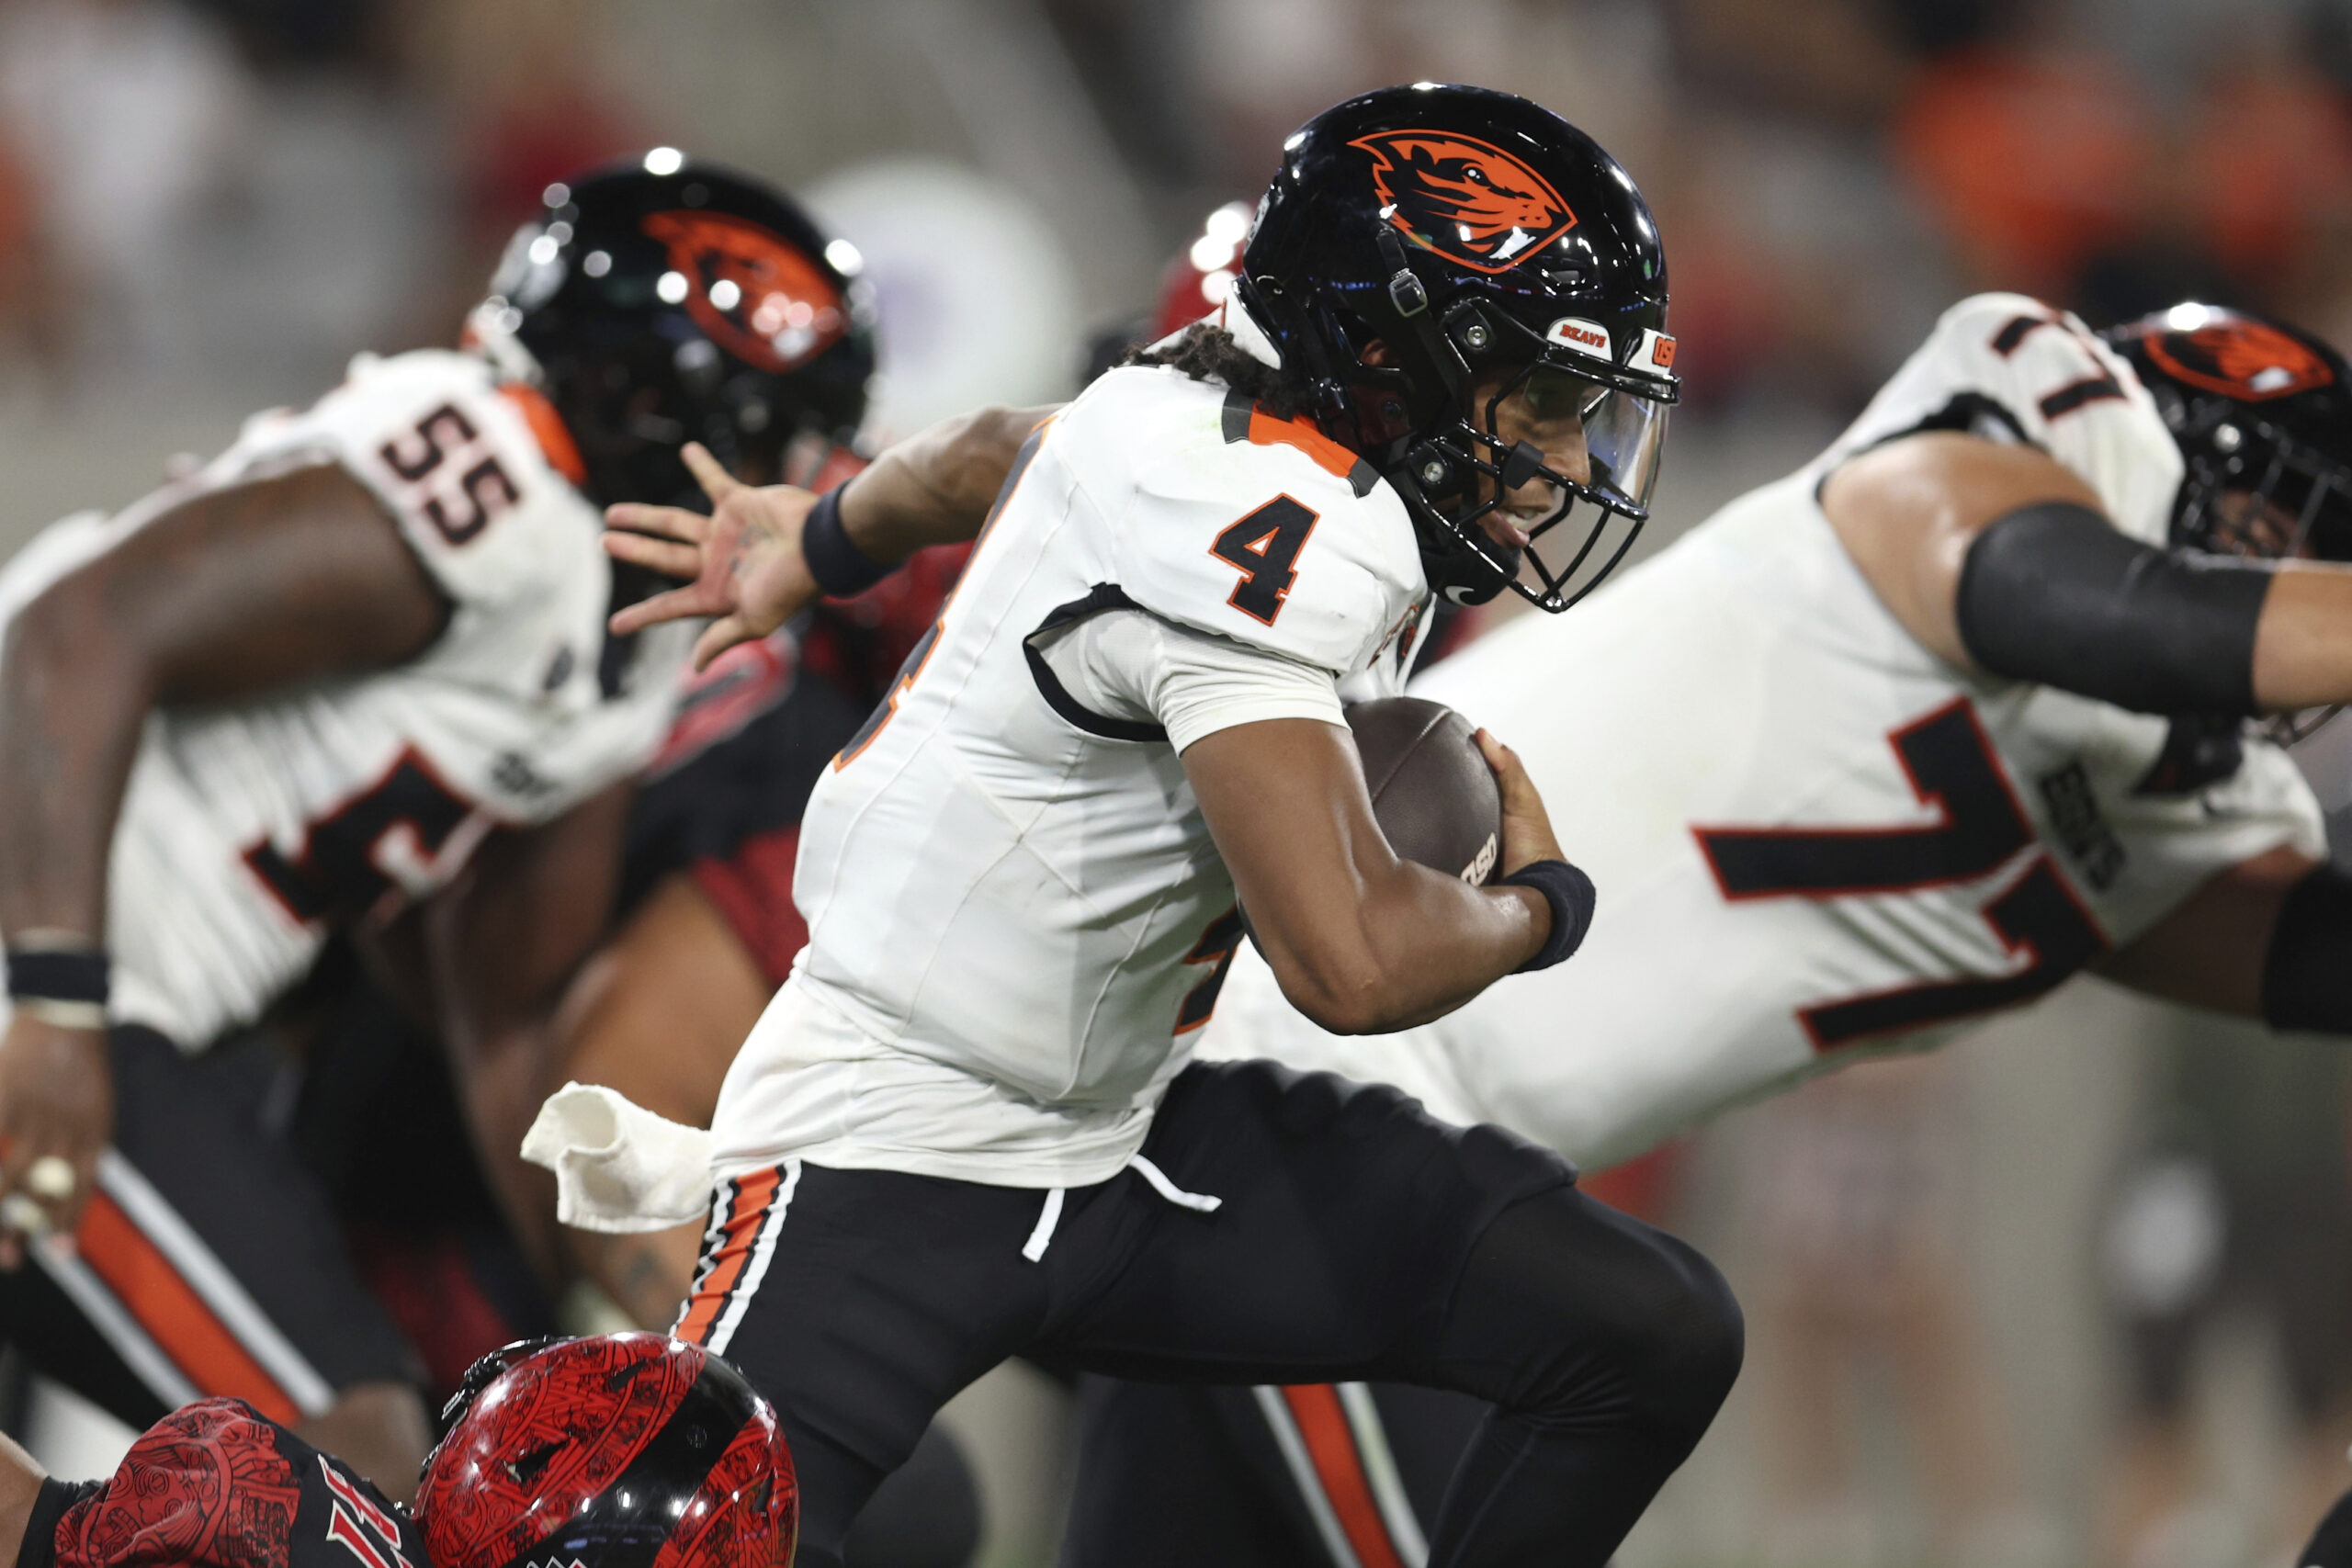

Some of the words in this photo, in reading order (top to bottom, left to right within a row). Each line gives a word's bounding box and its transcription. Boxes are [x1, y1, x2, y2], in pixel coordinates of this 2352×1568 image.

[1559, 323, 1607, 348] BEAVS
[1652, 335, 1677, 367] OS
[377, 401, 522, 547] 55
[1208, 492, 1320, 626] 4
[1687, 694, 2113, 1055] 77
